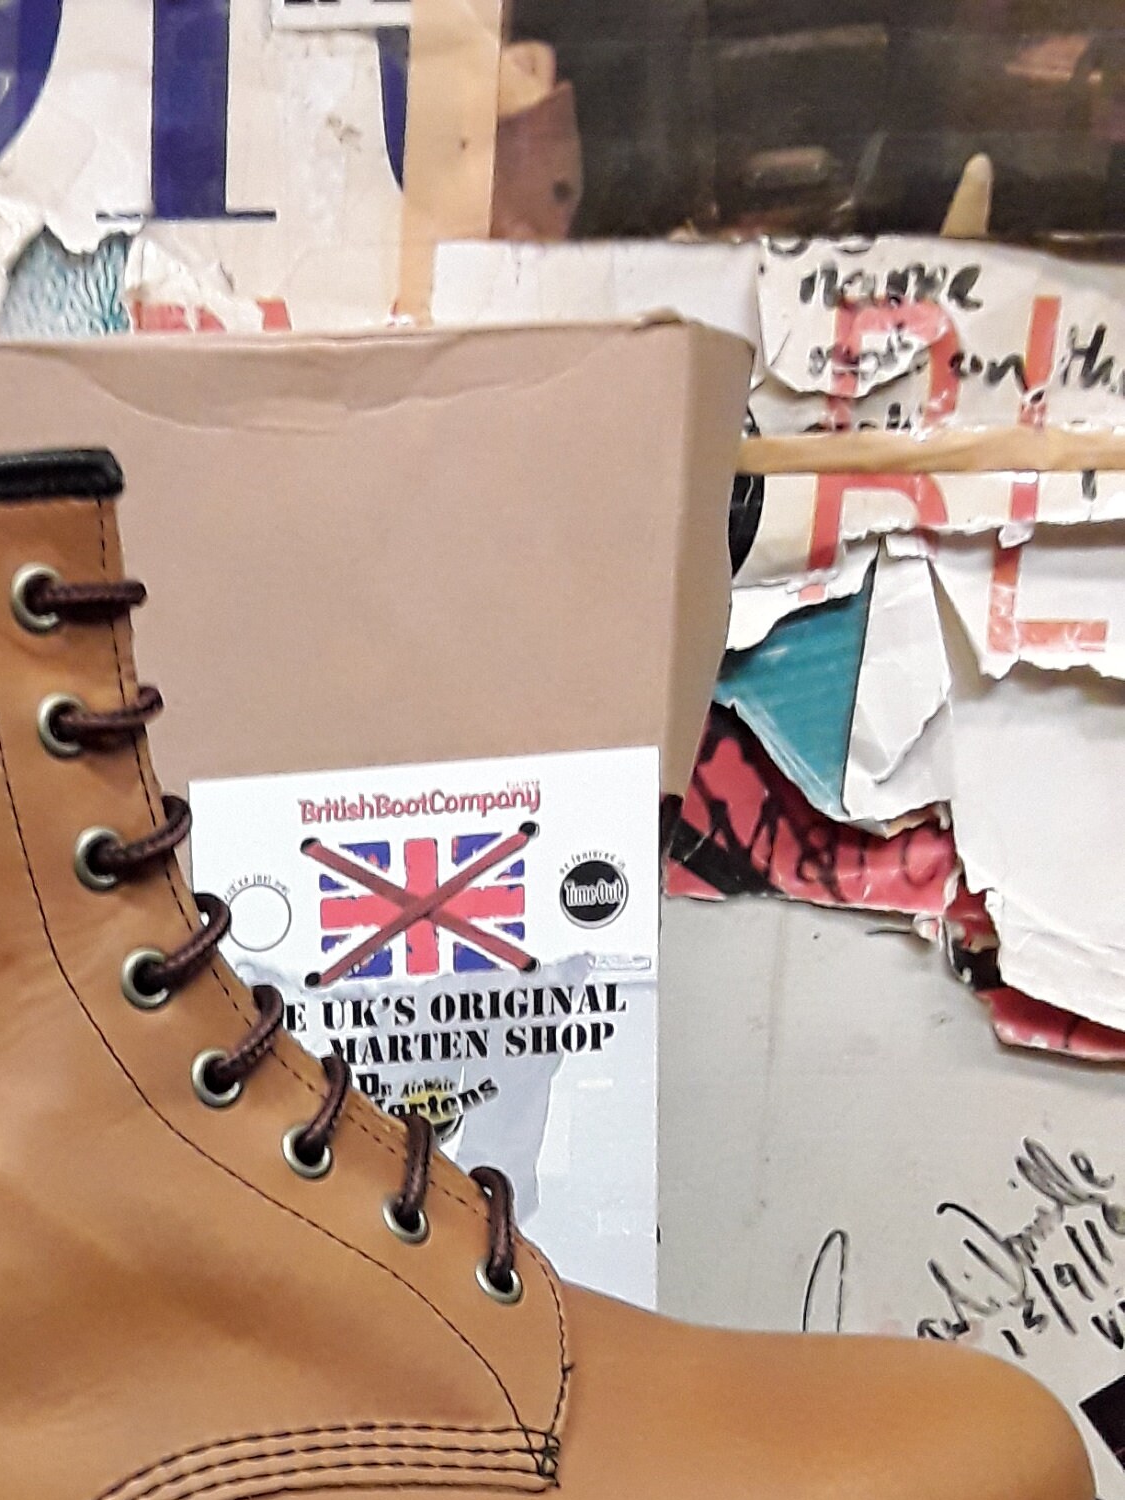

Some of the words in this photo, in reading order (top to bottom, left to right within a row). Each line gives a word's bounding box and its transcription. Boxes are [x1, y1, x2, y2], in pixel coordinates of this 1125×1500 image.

[321, 995, 416, 1031] UK'S
[429, 983, 628, 1025] ORIGINAL
[329, 1029, 490, 1065] MARTEN
[505, 1021, 616, 1057] SHOP
[375, 1077, 500, 1120] artens
